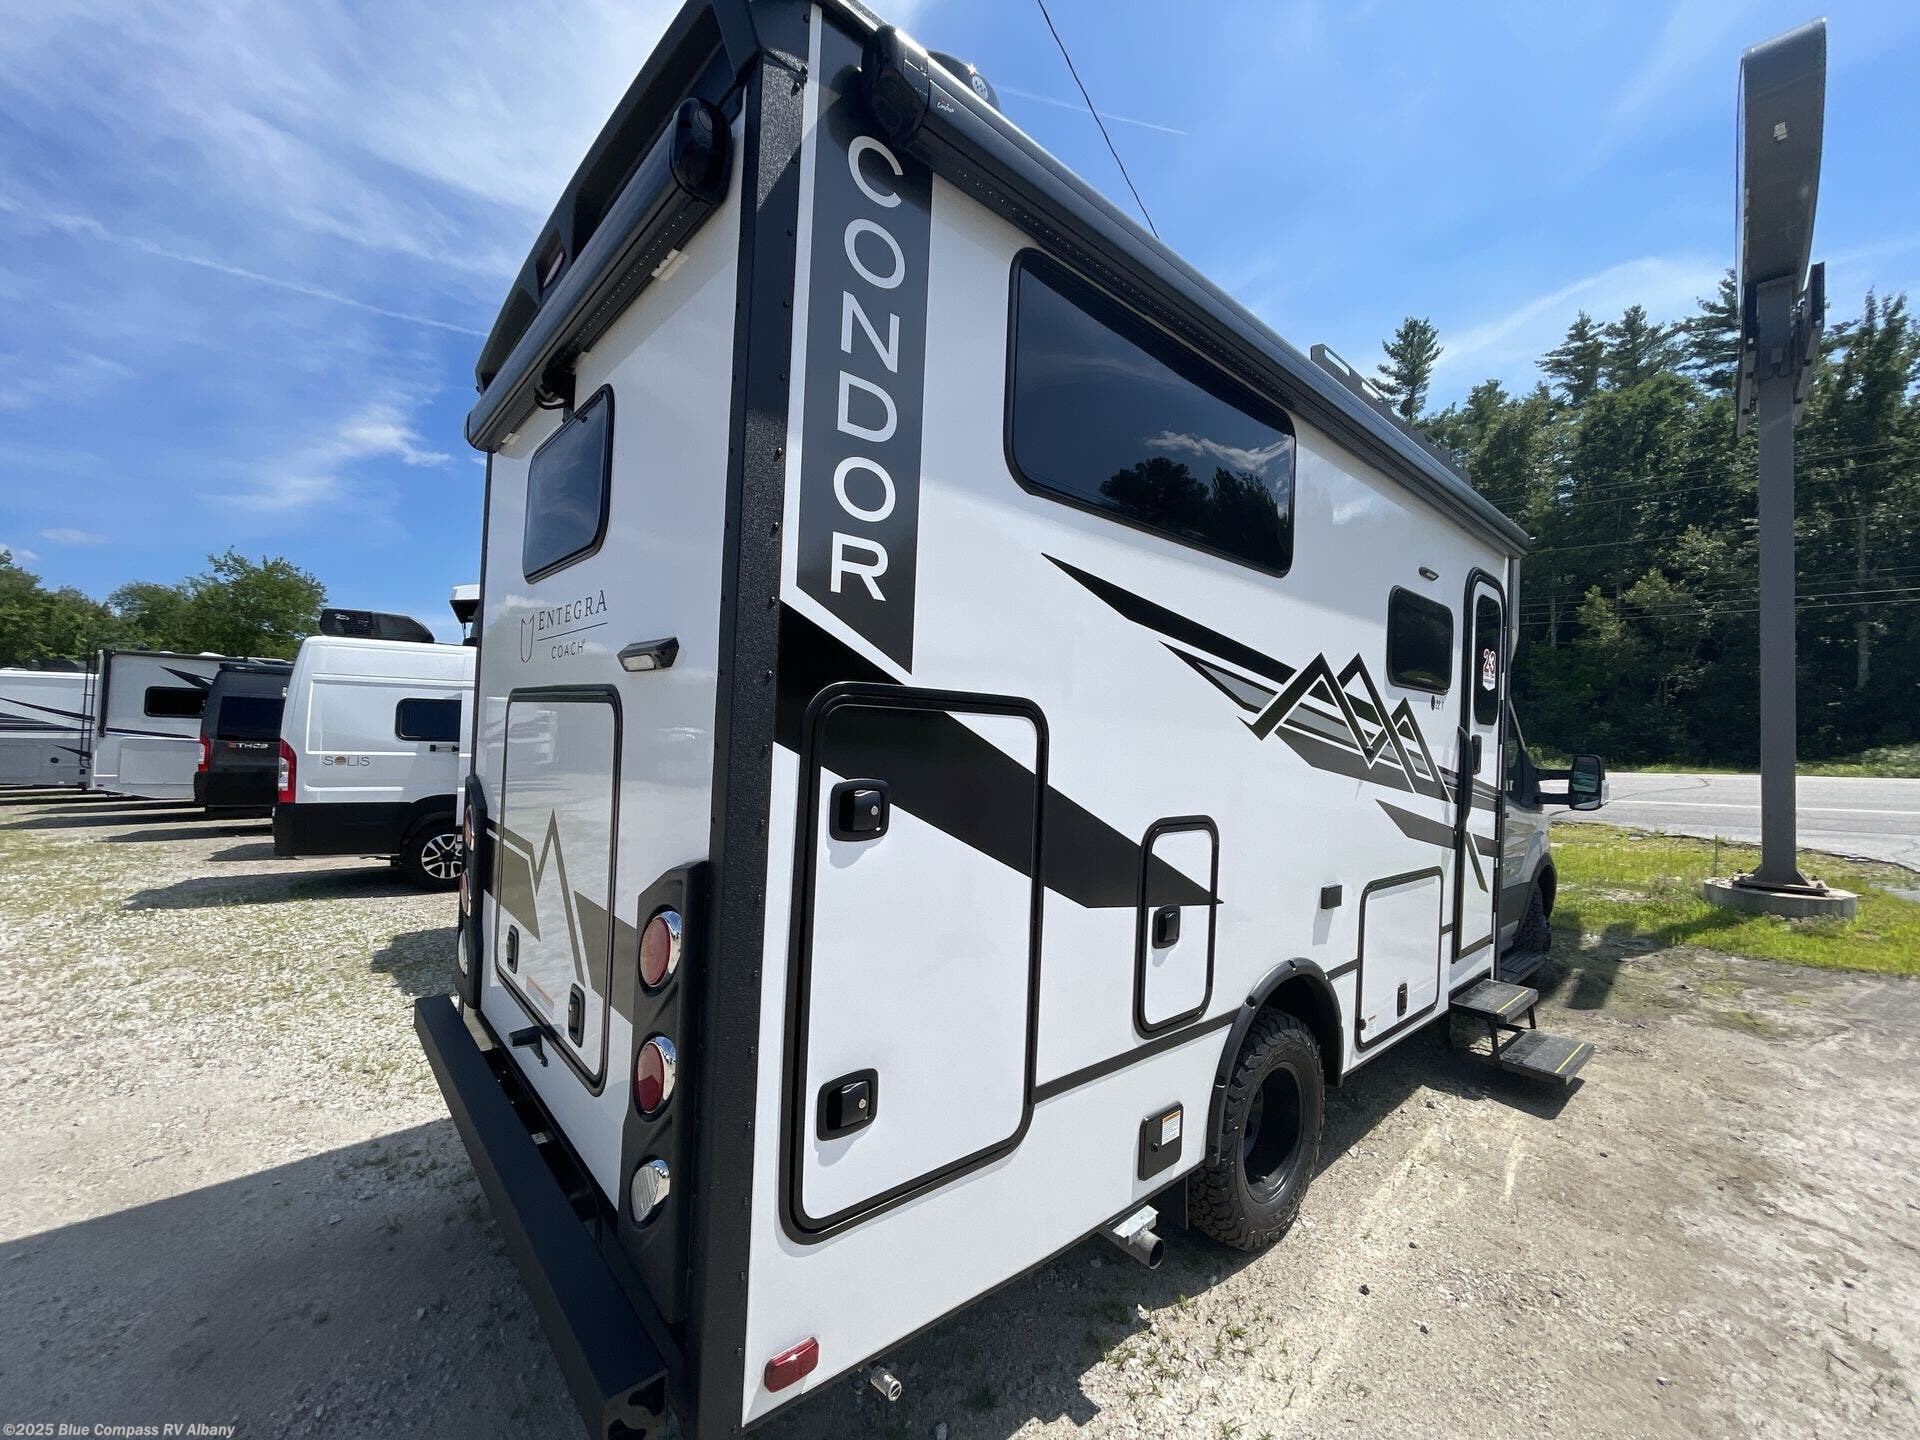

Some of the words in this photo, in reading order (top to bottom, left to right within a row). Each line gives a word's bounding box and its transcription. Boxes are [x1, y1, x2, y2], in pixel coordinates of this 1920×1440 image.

[830, 135, 906, 602] CONDOR
[538, 589, 608, 631] ENTEGRA
[323, 756, 370, 767] SOLIS
